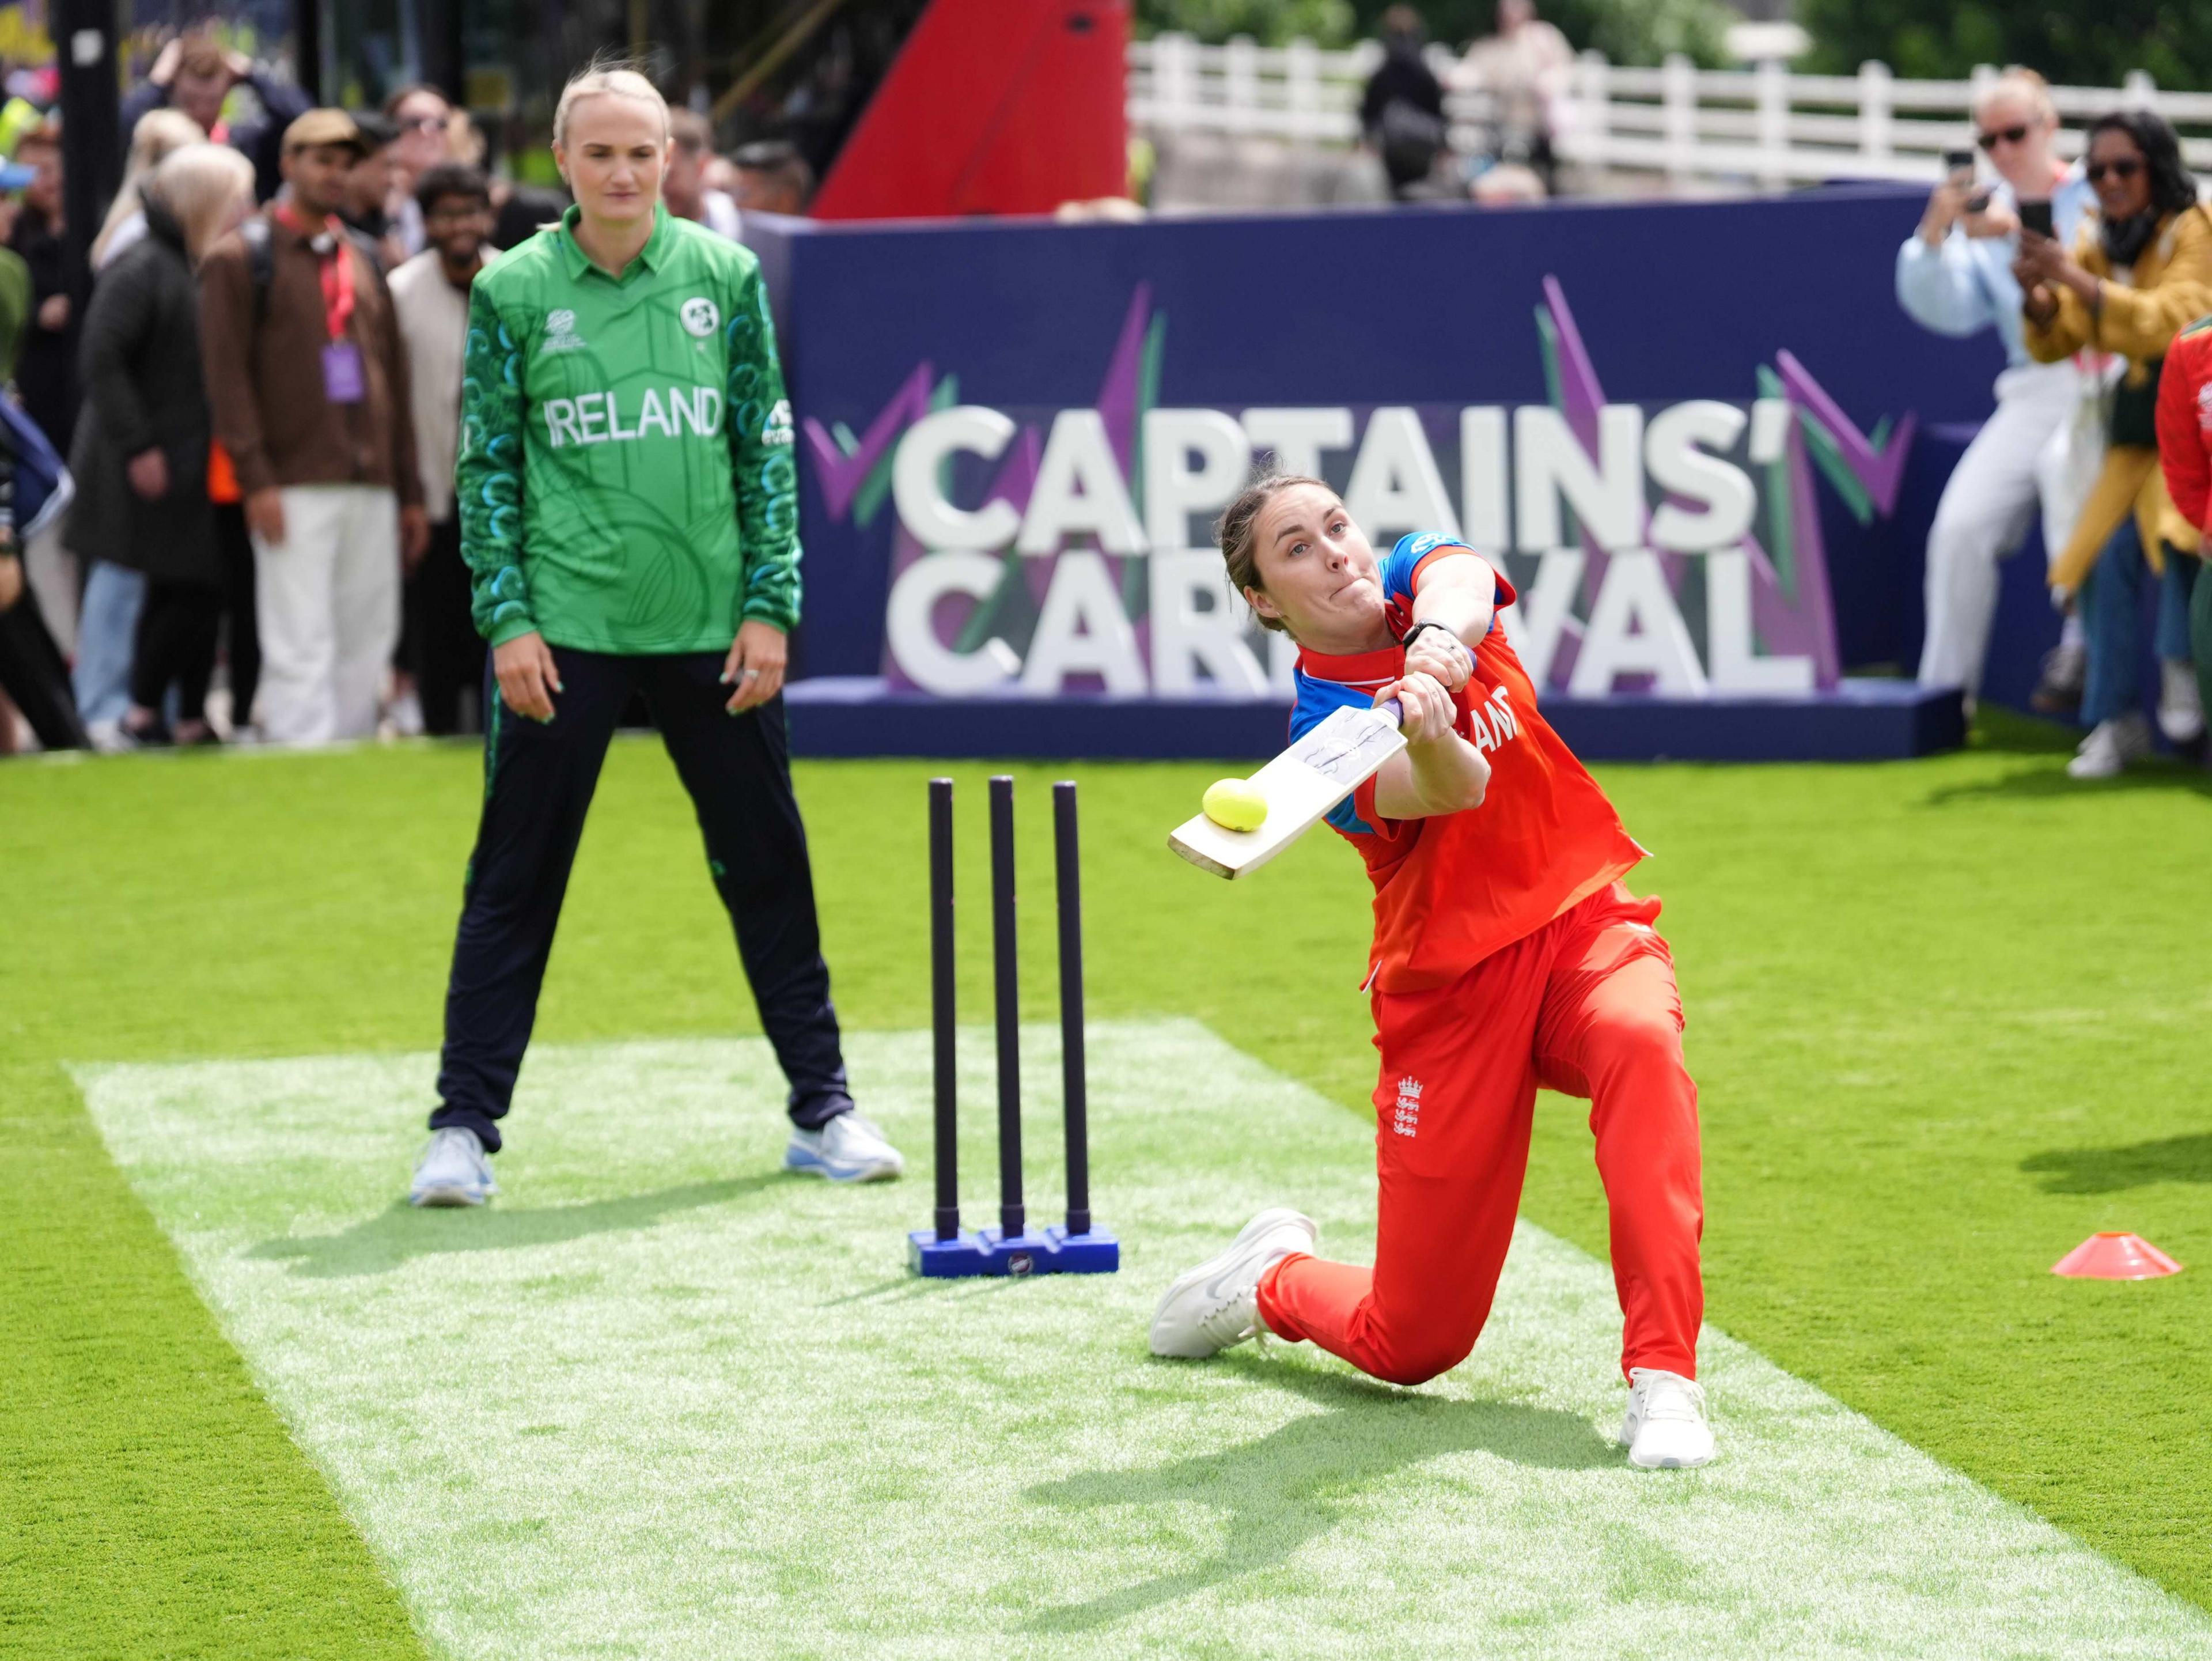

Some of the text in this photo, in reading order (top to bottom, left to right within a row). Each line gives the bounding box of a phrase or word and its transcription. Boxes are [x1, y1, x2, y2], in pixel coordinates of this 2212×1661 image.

[544, 386, 723, 448] IRELAND
[892, 398, 1790, 555] CAPTAINS'
[887, 548, 1817, 698] CARVAL
